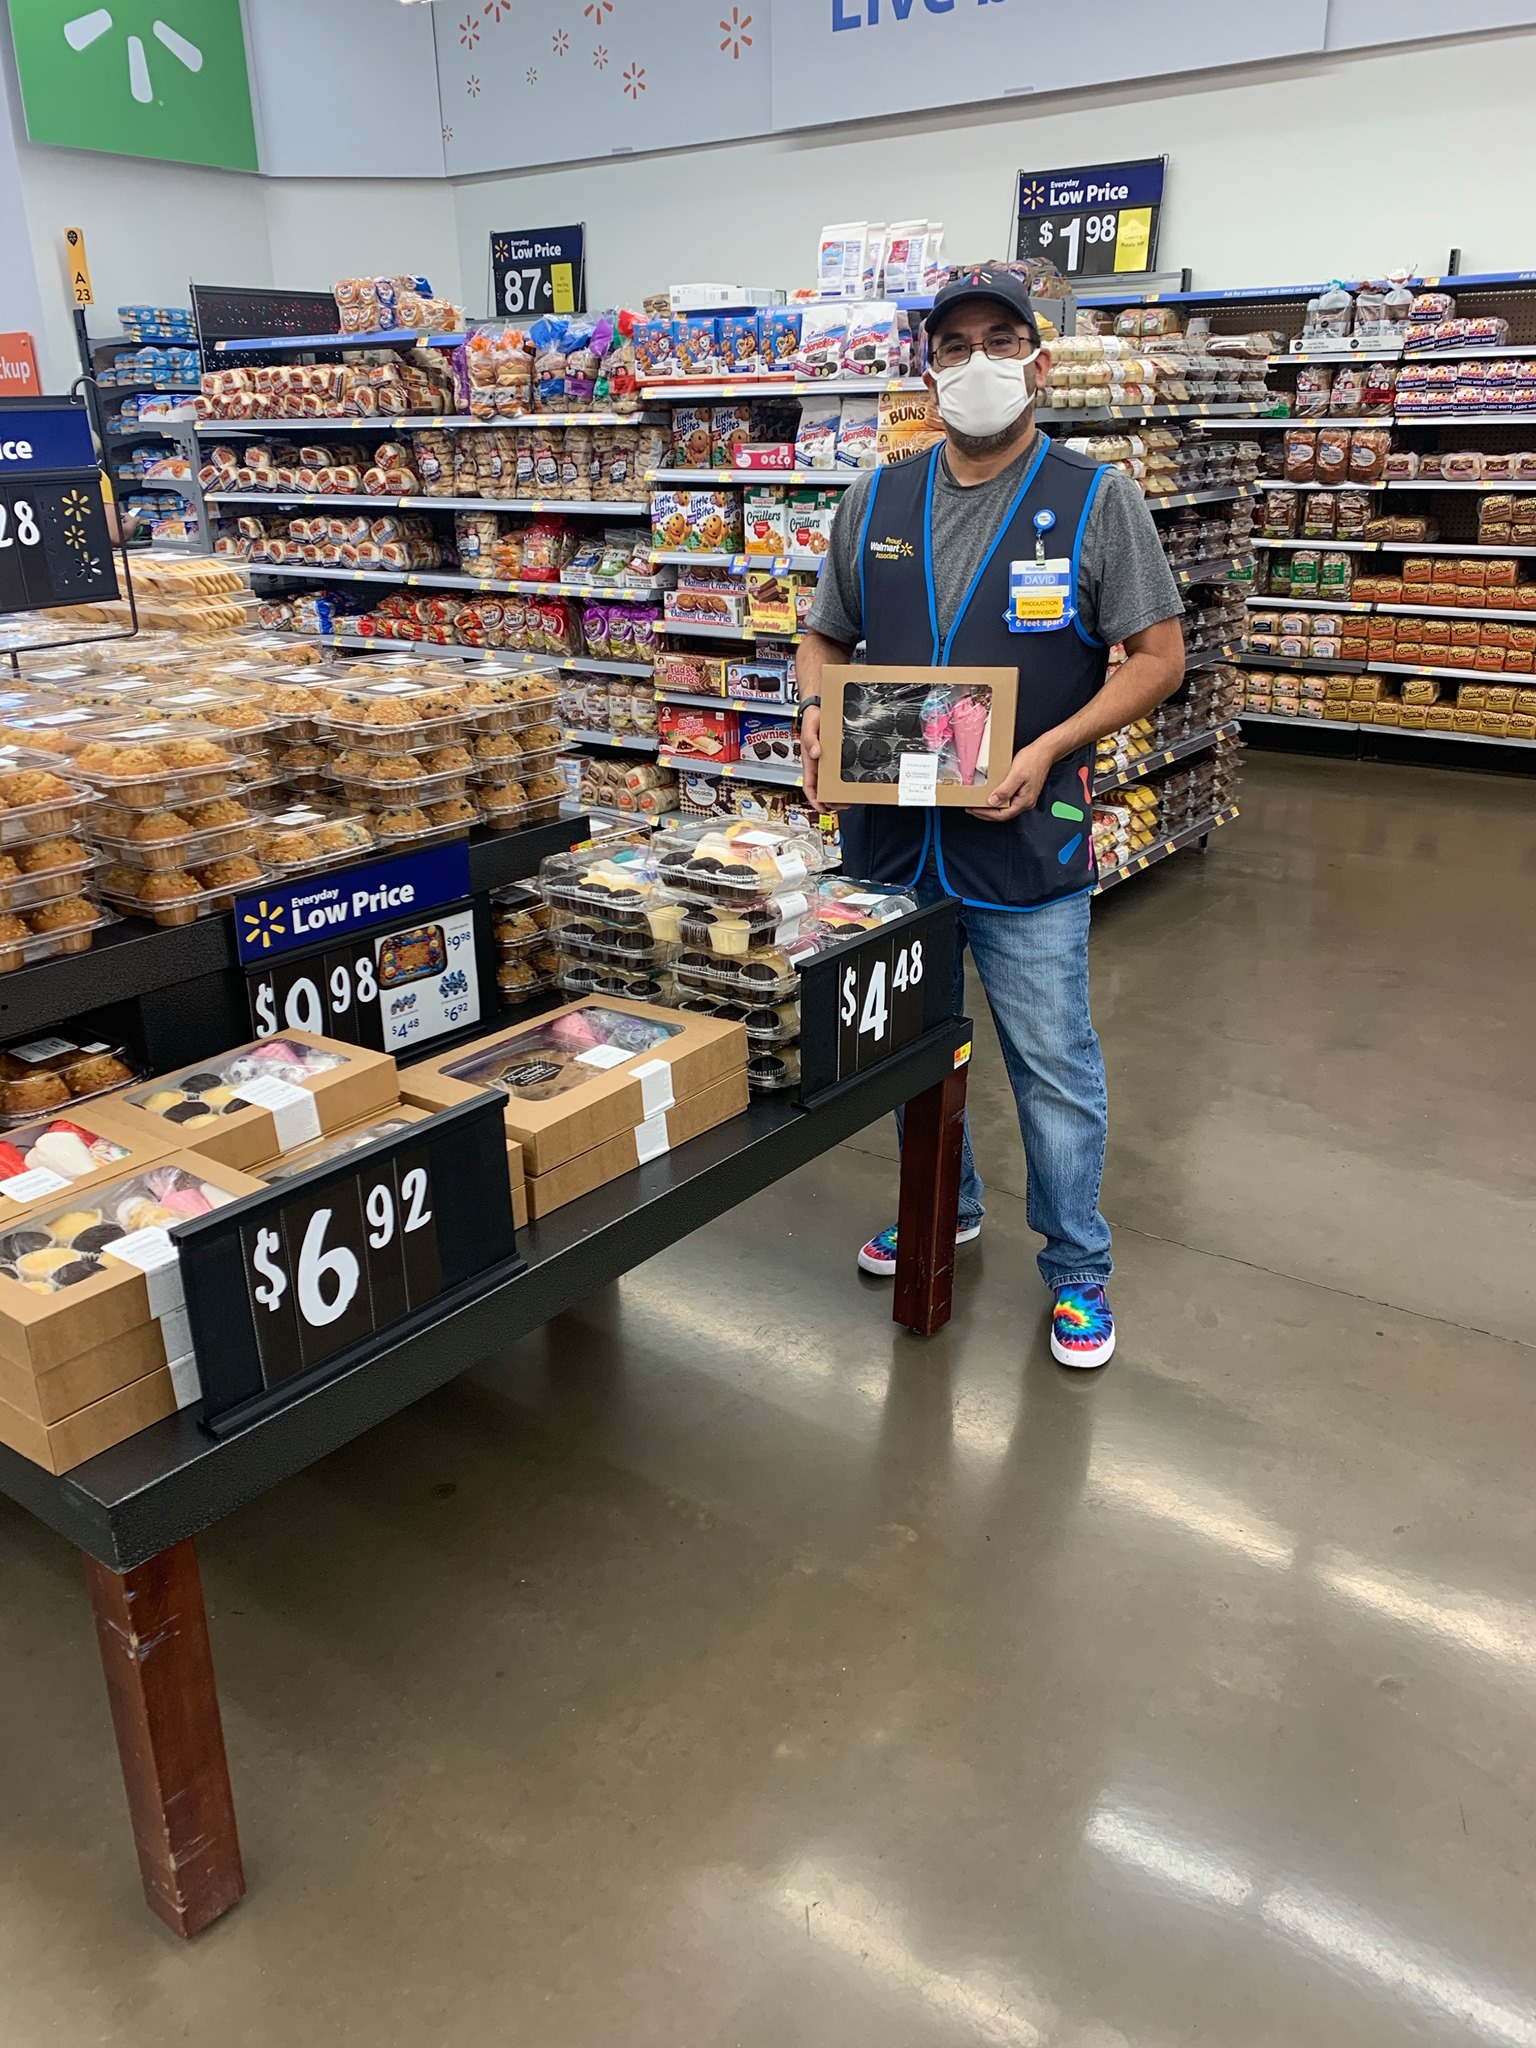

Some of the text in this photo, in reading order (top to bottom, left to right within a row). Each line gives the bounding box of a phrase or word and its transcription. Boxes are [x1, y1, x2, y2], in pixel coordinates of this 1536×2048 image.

[1050, 179, 1080, 189] Everyday
[1050, 182, 1129, 206] Low Price
[511, 242, 562, 260] Low Price
[75, 271, 87, 284] A
[75, 288, 91, 301] 23
[676, 409, 694, 429] Little
[715, 408, 733, 428] Little
[889, 406, 926, 425] BUNS
[682, 420, 700, 436] Bites
[721, 420, 740, 435] Bites
[654, 495, 672, 512] Little
[690, 494, 709, 512] Little
[660, 505, 678, 519] Bites
[696, 505, 716, 520] Bites
[747, 508, 781, 526] Crullers
[790, 516, 820, 533] Crullers
[870, 541, 900, 553] Walmart
[886, 536, 902, 544] Proud
[875, 552, 899, 560] Associate
[684, 578, 746, 591] Oatmeal Creme Pies
[1025, 575, 1056, 585] DAVID
[671, 610, 732, 623] Oatmeal Creme Pies
[1023, 619, 1040, 627] feet
[1041, 619, 1064, 628] apart
[670, 663, 696, 676] Fudge
[667, 673, 699, 686] Rounds
[745, 729, 789, 745] Brownies
[688, 788, 713, 797] Chocolate
[291, 888, 339, 908] Everyday
[292, 884, 415, 934] Low Price
